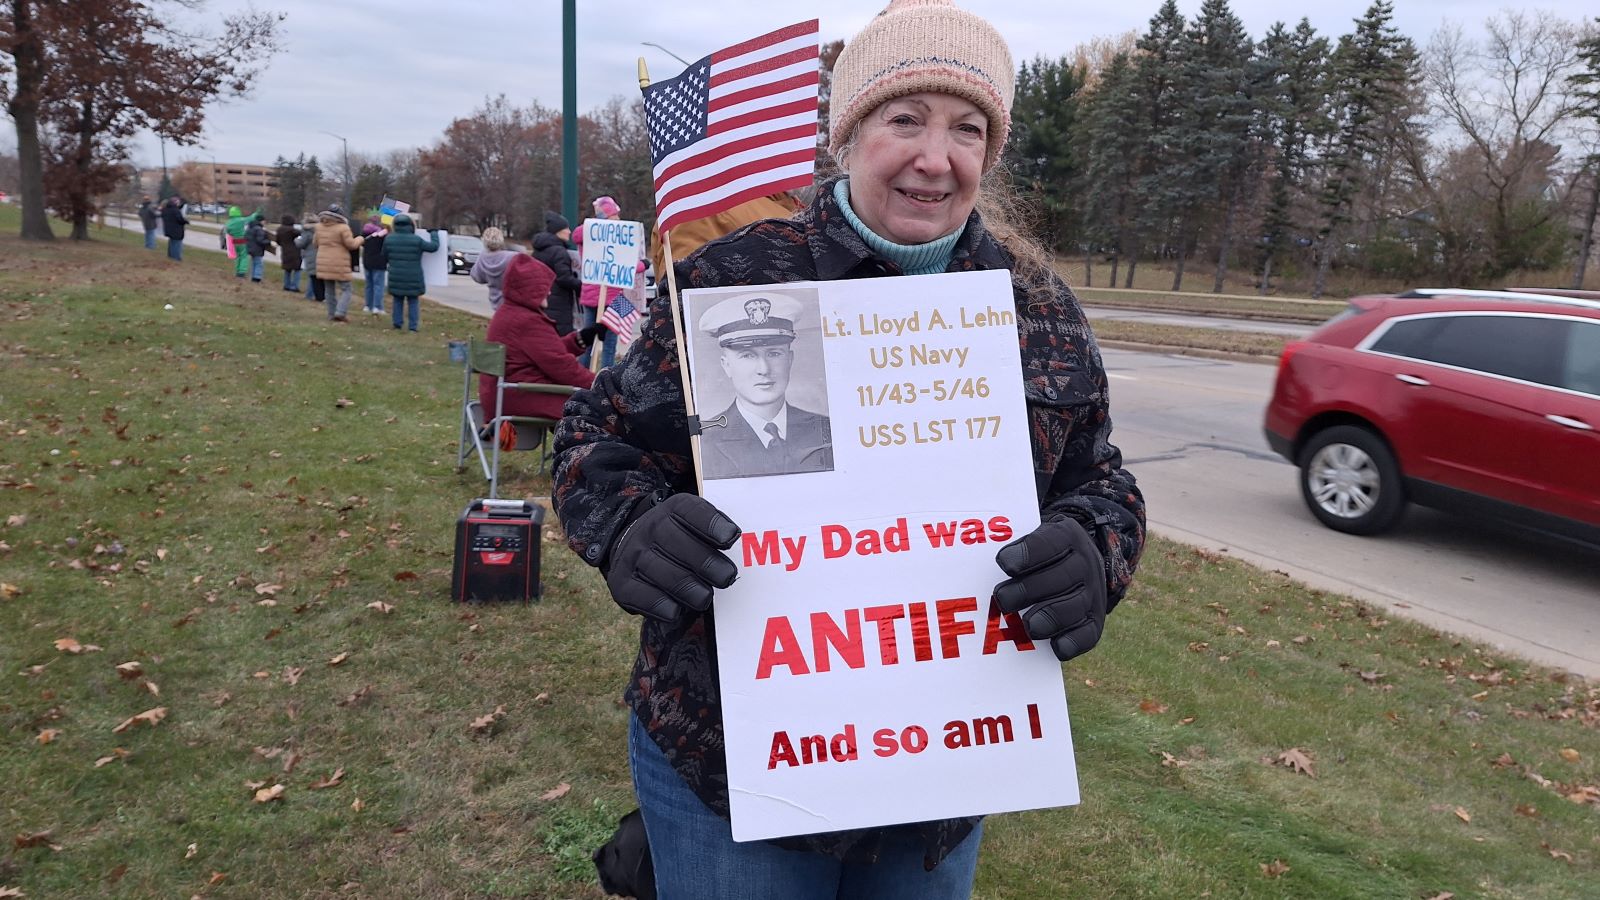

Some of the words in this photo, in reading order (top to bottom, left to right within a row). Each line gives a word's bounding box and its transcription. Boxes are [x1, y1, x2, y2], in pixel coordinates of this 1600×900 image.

[590, 222, 634, 246] COURAGE
[603, 246, 614, 263] IS
[583, 259, 634, 286] CONTAGIOUS
[823, 315, 852, 336] Lt.
[859, 308, 920, 337] Lloyd
[928, 309, 953, 331] A.
[960, 306, 1014, 329] Lehn
[870, 346, 903, 369] US
[910, 344, 969, 368] Navy
[857, 376, 990, 407] 11/43-5/46
[859, 423, 907, 448] USS
[914, 419, 957, 443] LST
[965, 415, 1002, 439] 177
[741, 530, 807, 572] My
[821, 517, 910, 559] Dad
[923, 515, 1013, 549] was
[755, 595, 1036, 680] ANTIFA
[767, 724, 858, 770] And
[872, 725, 929, 758] so
[943, 712, 1014, 750] am
[1026, 704, 1043, 740] I
